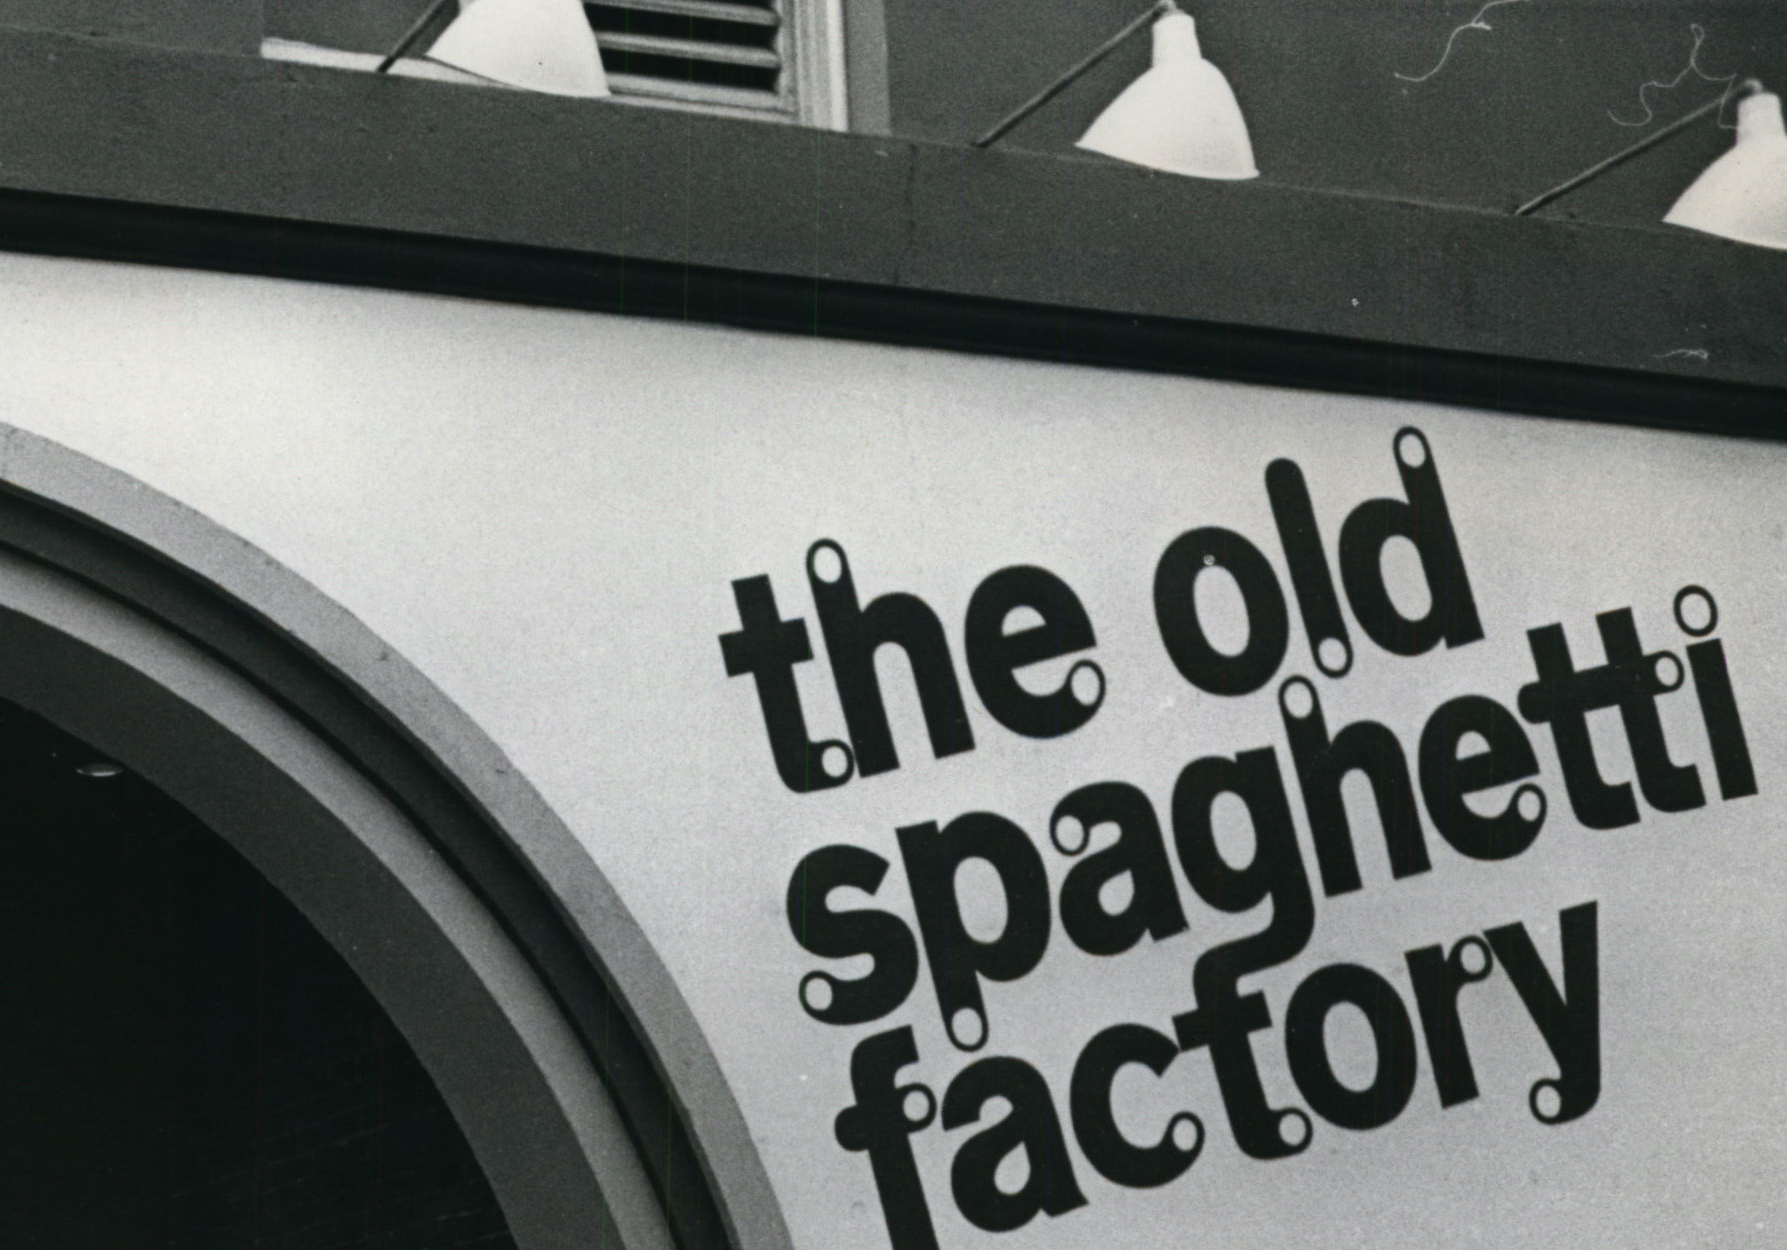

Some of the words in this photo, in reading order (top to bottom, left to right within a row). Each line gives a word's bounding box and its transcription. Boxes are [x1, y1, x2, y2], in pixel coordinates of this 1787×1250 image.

[719, 537, 1107, 793] the
[1152, 425, 1486, 697] old
[785, 584, 1759, 1052] spaghetti
